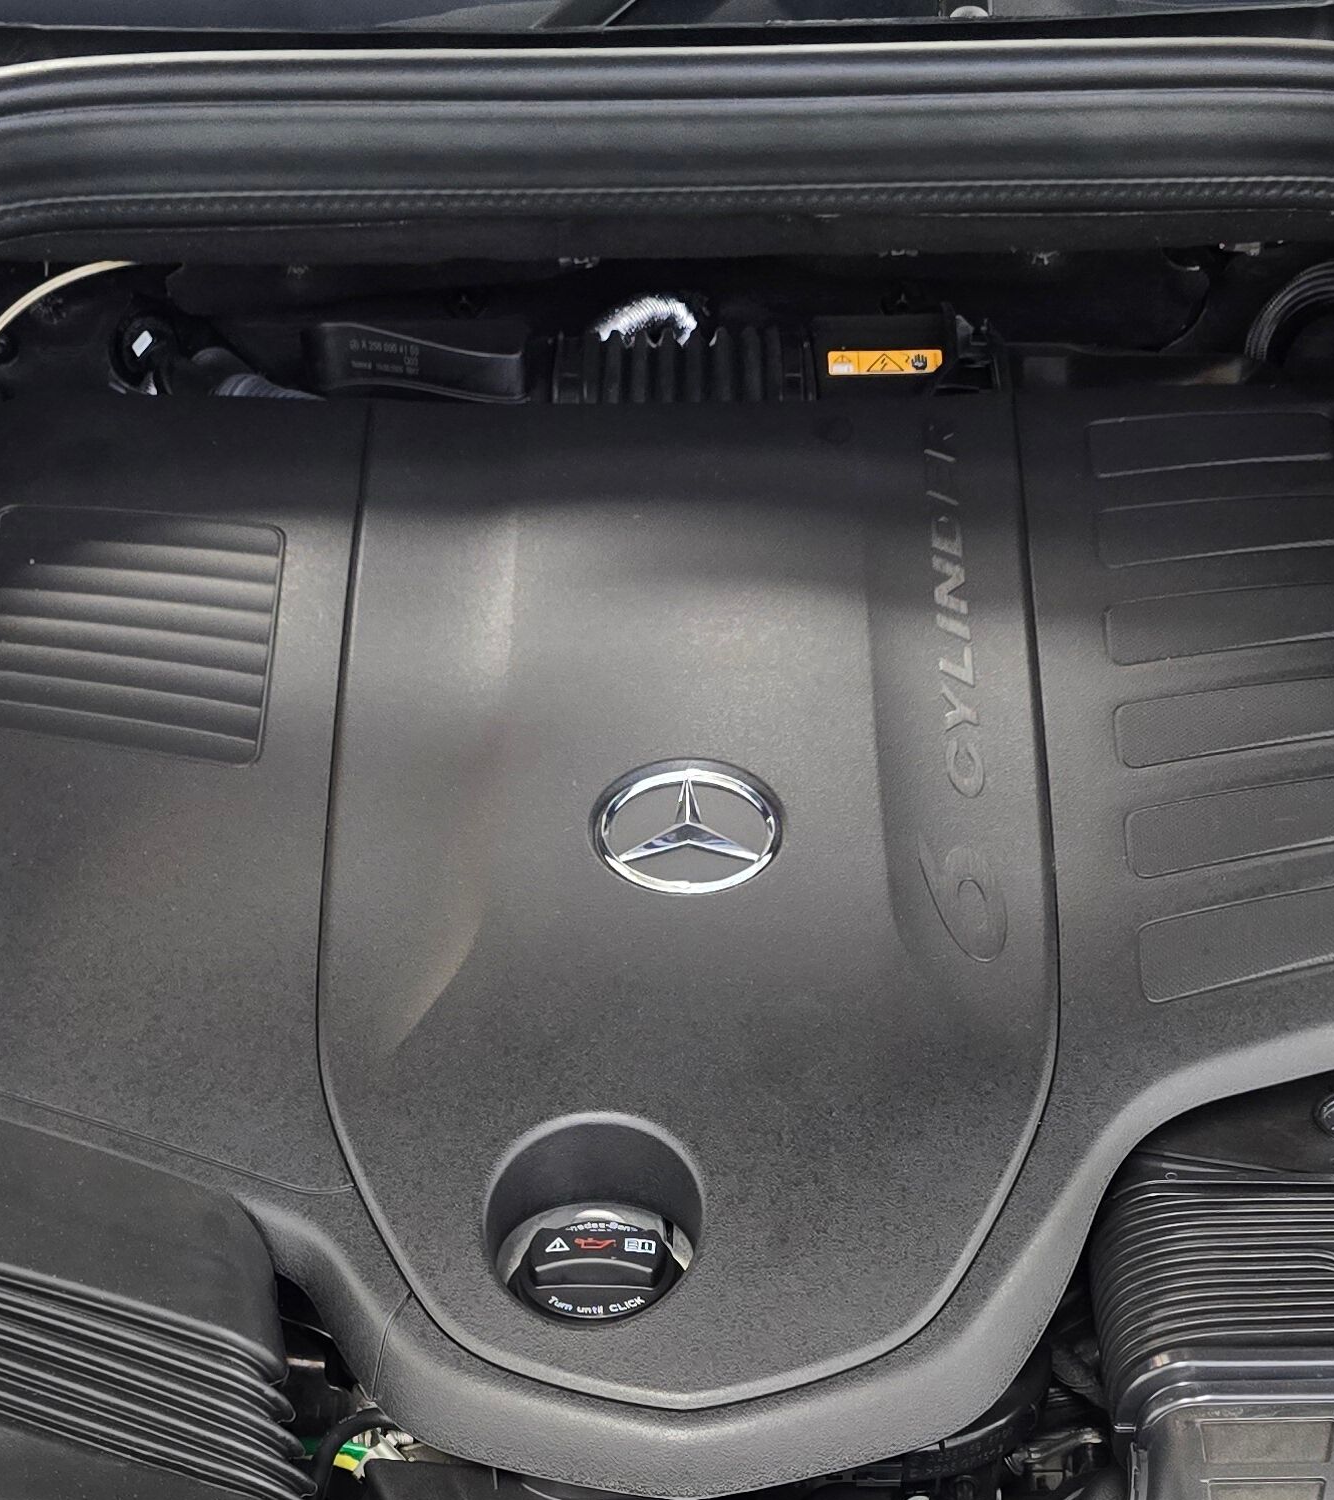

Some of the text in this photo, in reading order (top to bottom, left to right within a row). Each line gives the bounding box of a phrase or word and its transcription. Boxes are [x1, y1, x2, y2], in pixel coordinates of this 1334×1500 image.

[548, 1295, 646, 1315] Turn until CLICK
